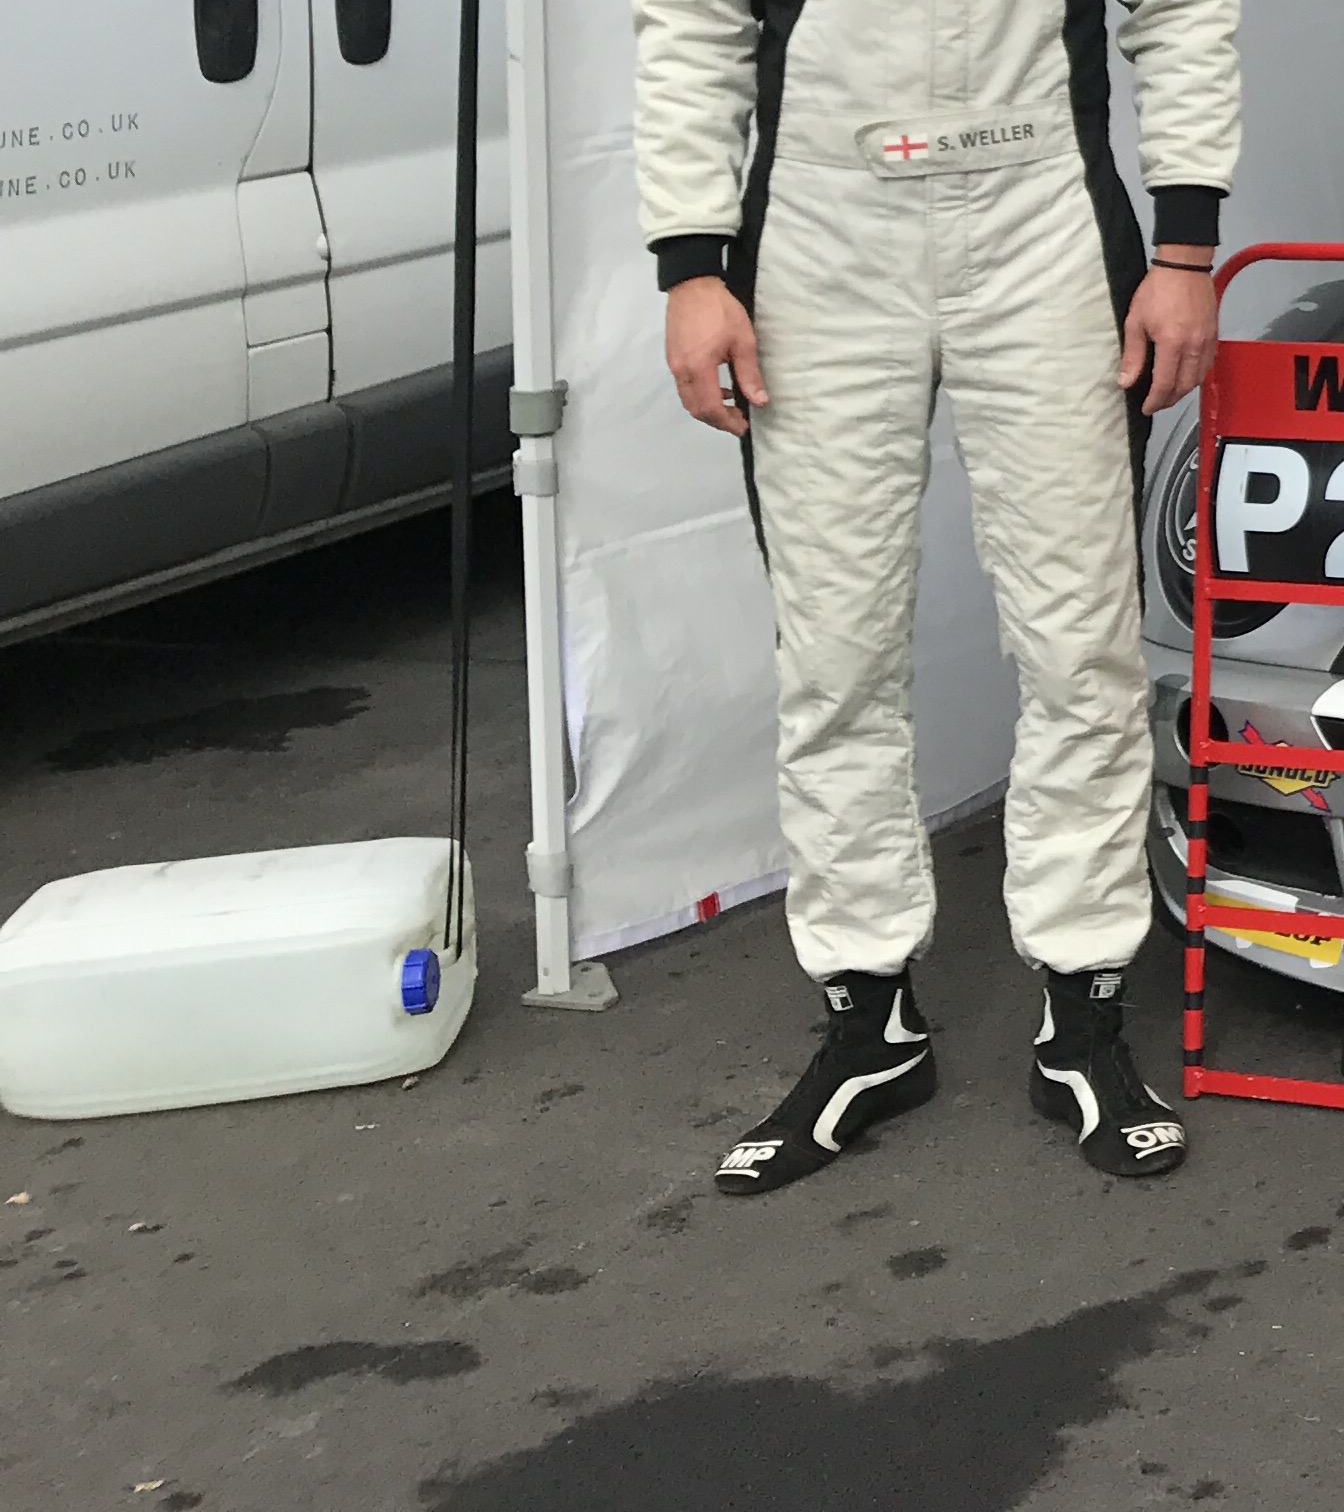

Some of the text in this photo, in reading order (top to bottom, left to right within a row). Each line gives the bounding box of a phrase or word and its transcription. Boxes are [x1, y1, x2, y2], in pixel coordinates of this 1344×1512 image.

[937, 123, 1035, 152] S. WELLER
[0, 160, 136, 197] NE.CO.UK
[1126, 1126, 1184, 1149] OM
[718, 1146, 777, 1170] MP
